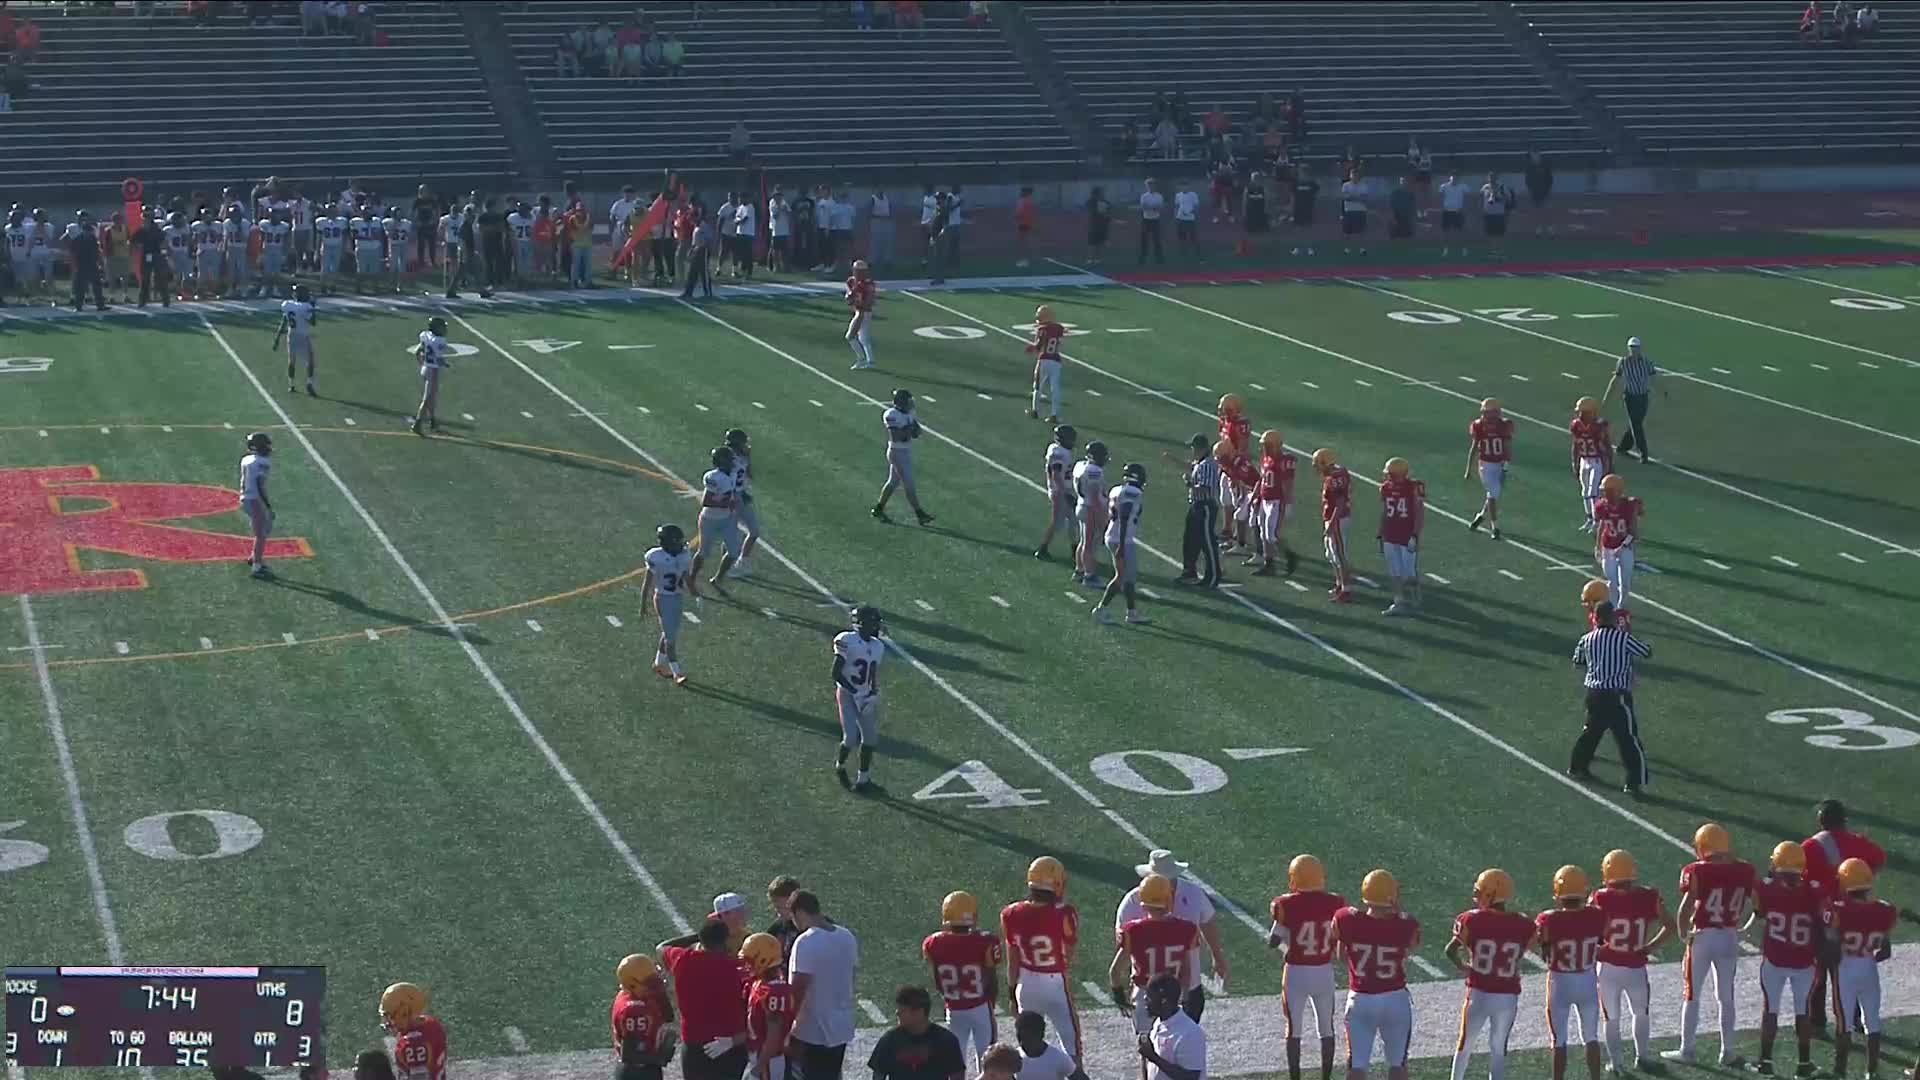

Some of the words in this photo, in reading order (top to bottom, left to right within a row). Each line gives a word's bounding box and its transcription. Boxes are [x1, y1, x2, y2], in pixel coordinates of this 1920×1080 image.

[1386, 497, 1409, 518] 54
[1705, 887, 1745, 923] 44
[1296, 920, 1332, 956] 41
[1609, 918, 1646, 953] 21
[1767, 911, 1812, 945] 26
[1016, 934, 1056, 967] 12
[1144, 945, 1185, 979] 15
[1352, 943, 1398, 979] 75
[1473, 939, 1520, 978] 83
[1557, 936, 1599, 972] 30
[938, 963, 983, 1000] 23
[768, 996, 785, 1011] 81
[626, 1017, 646, 1031] 85
[405, 1046, 427, 1063] 22
